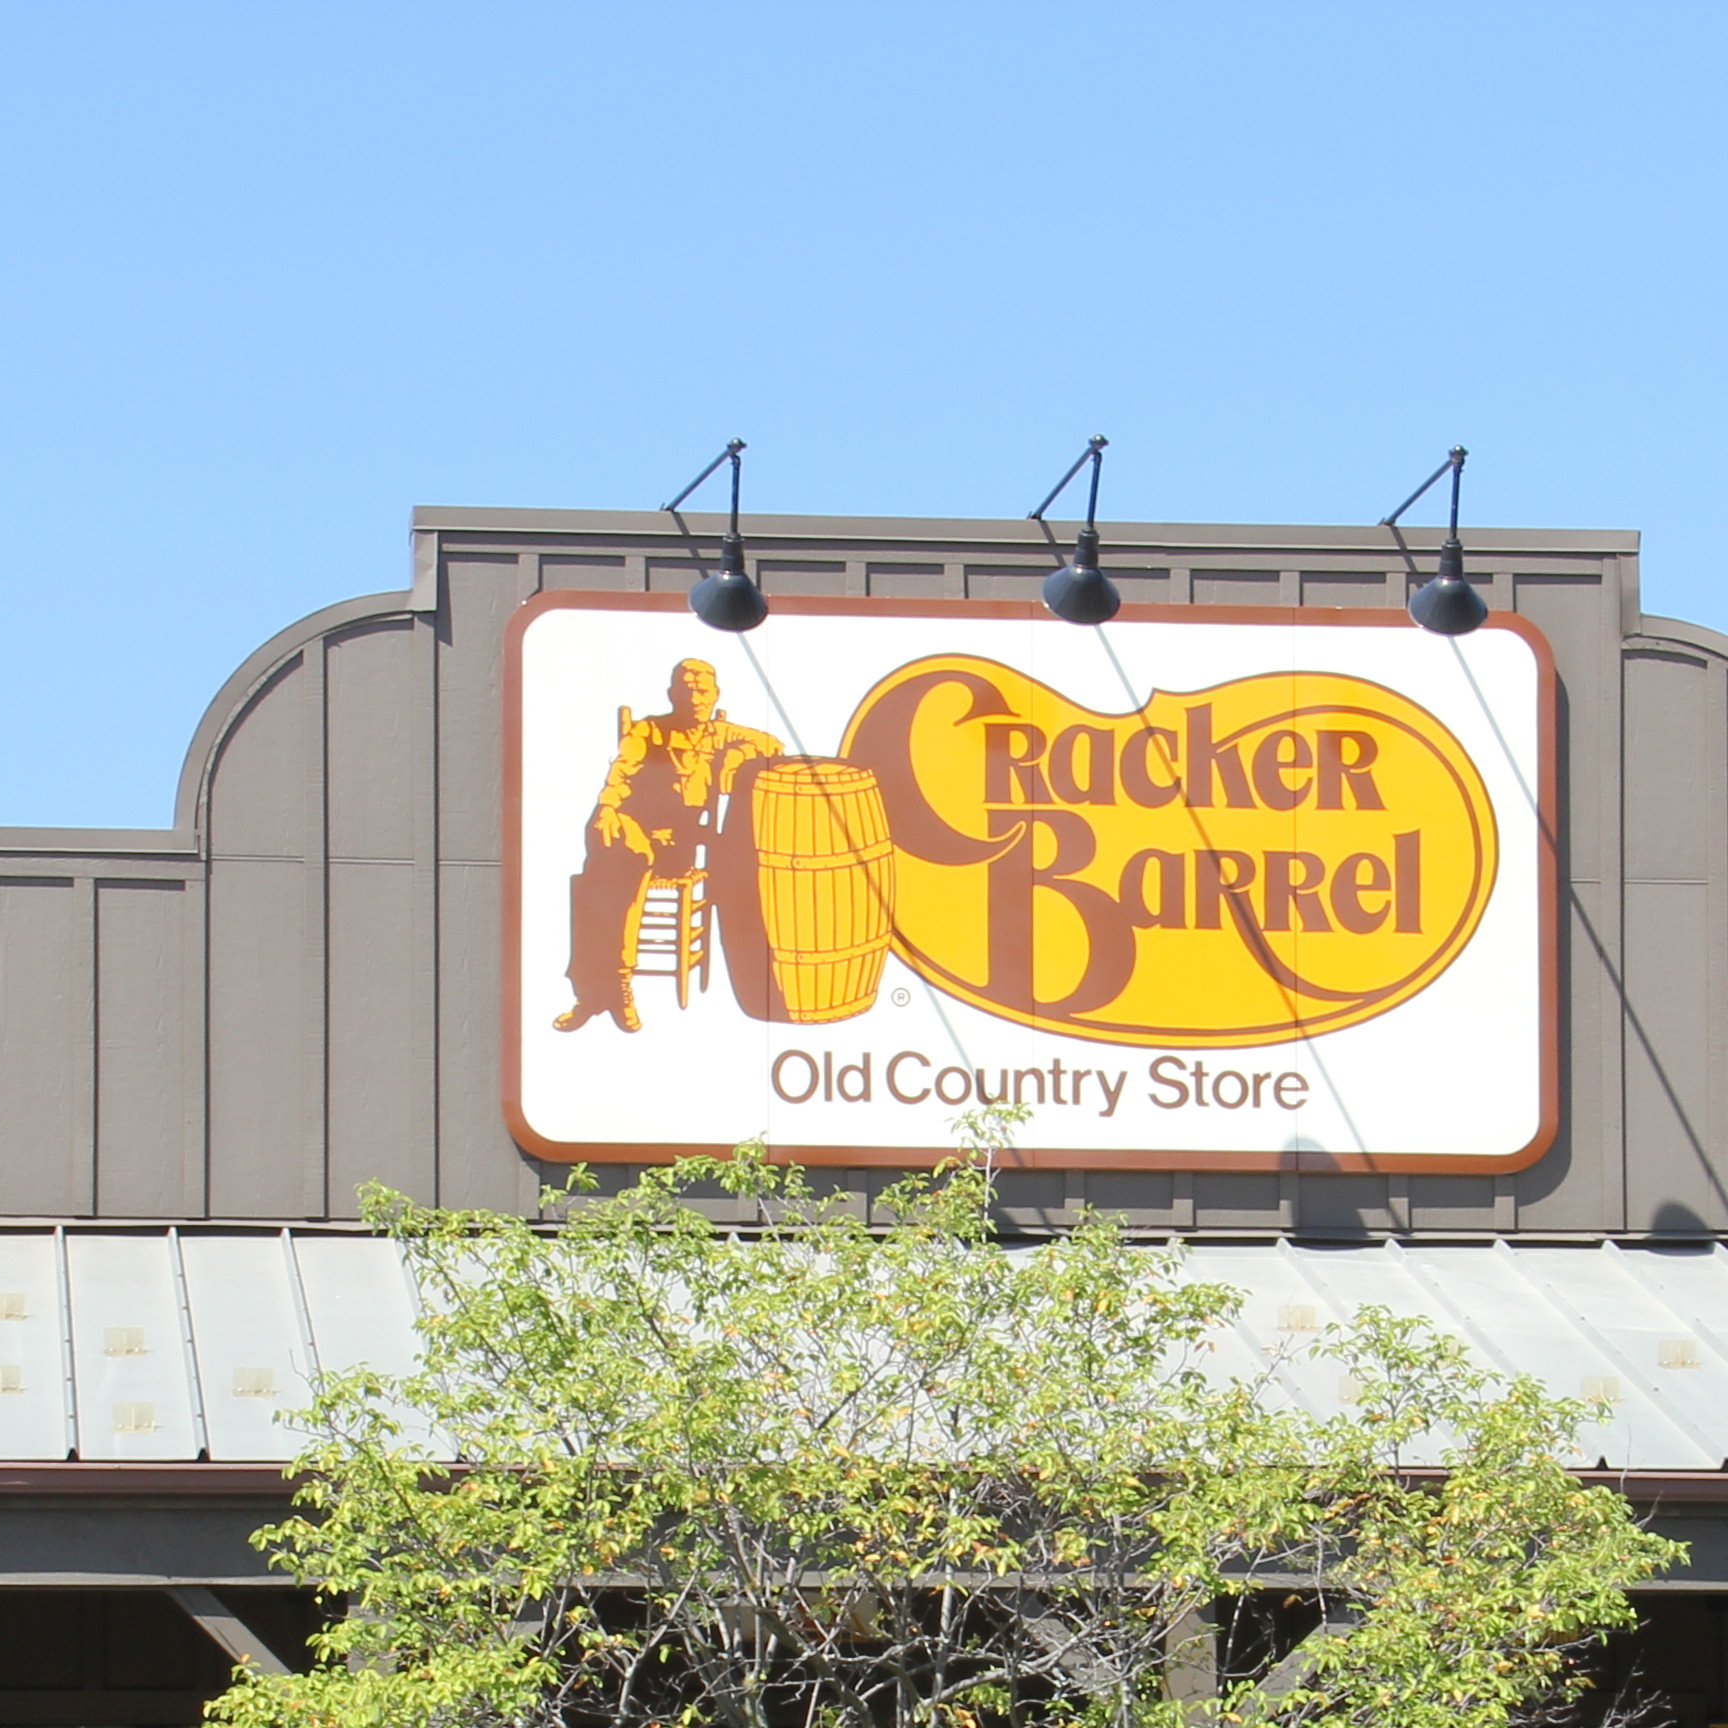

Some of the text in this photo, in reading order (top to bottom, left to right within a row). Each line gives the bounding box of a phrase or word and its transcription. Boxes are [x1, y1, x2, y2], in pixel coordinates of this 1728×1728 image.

[771, 1049, 1310, 1118] Old Country Store
